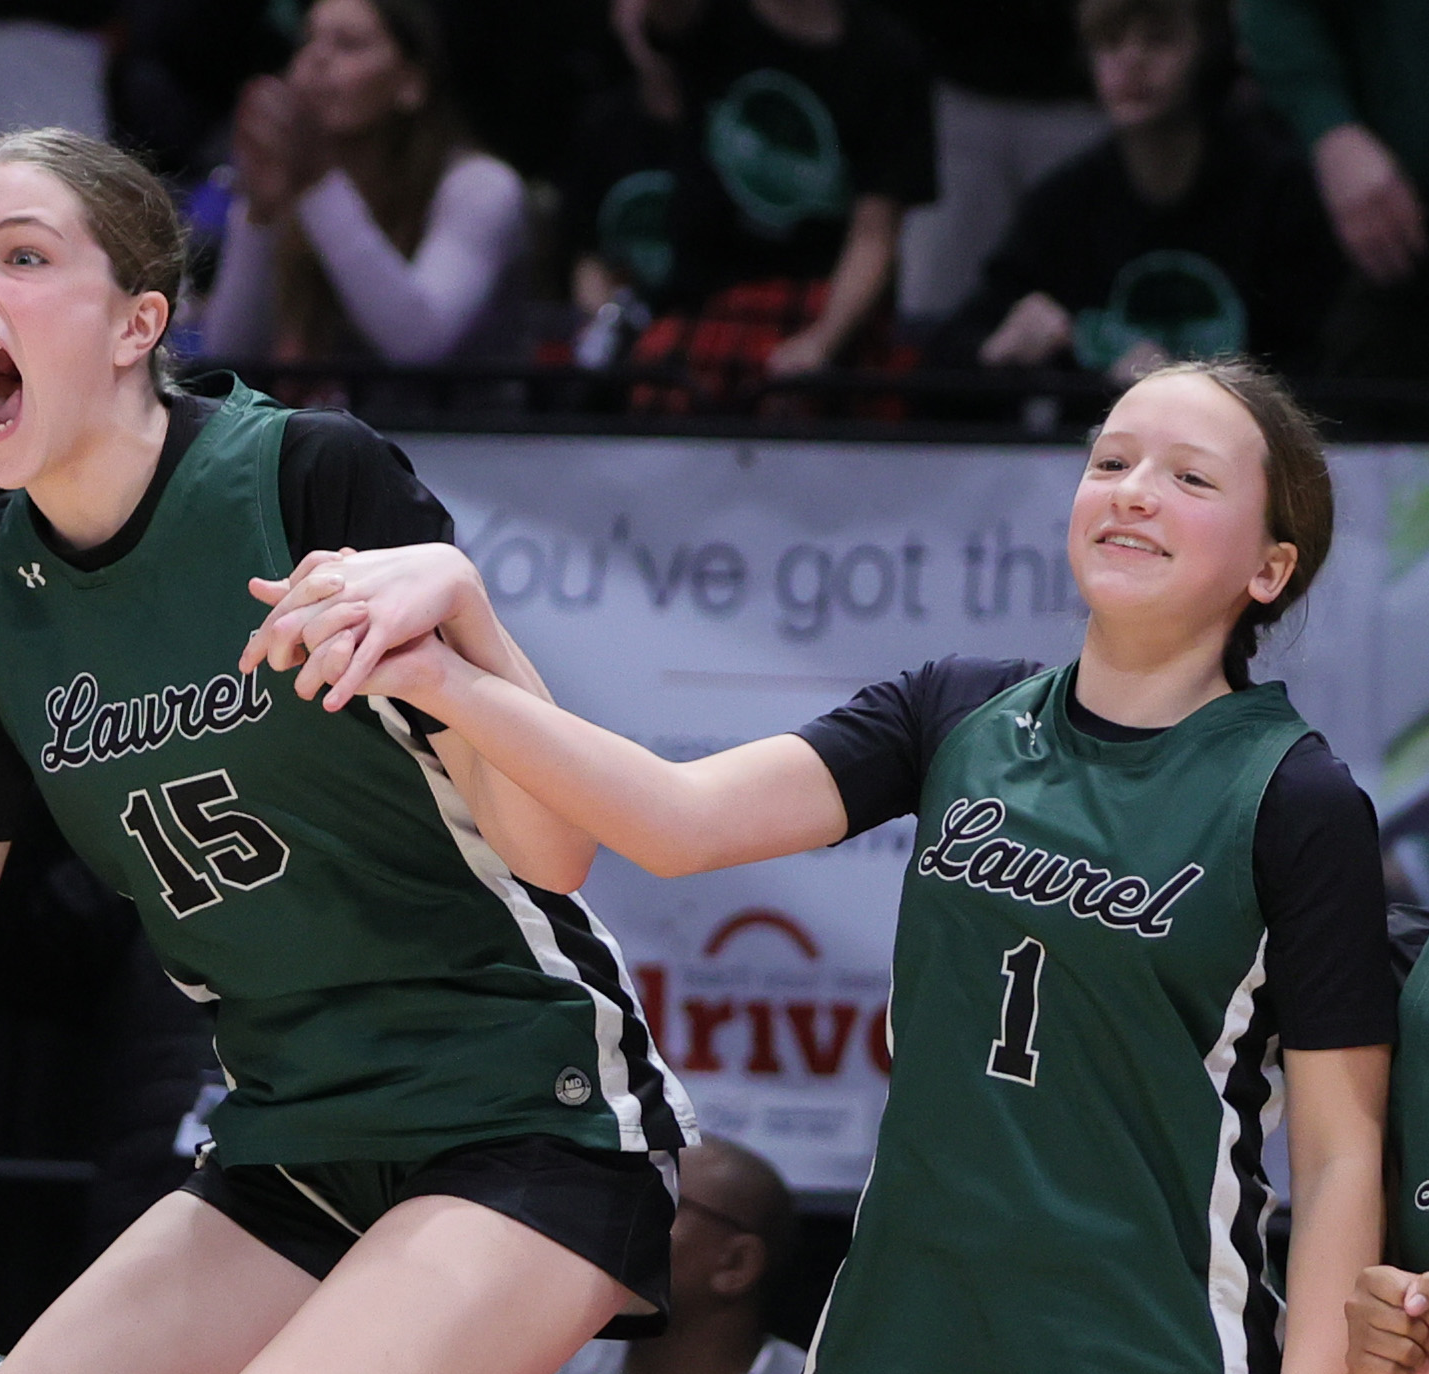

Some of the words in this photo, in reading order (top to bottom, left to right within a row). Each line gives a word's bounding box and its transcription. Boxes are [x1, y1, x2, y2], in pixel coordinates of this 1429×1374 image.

[775, 533, 928, 644] got
[964, 518, 1078, 622] thi
[120, 769, 290, 919] 15
[918, 798, 1204, 937] Laurel
[986, 936, 1045, 1087] 1
